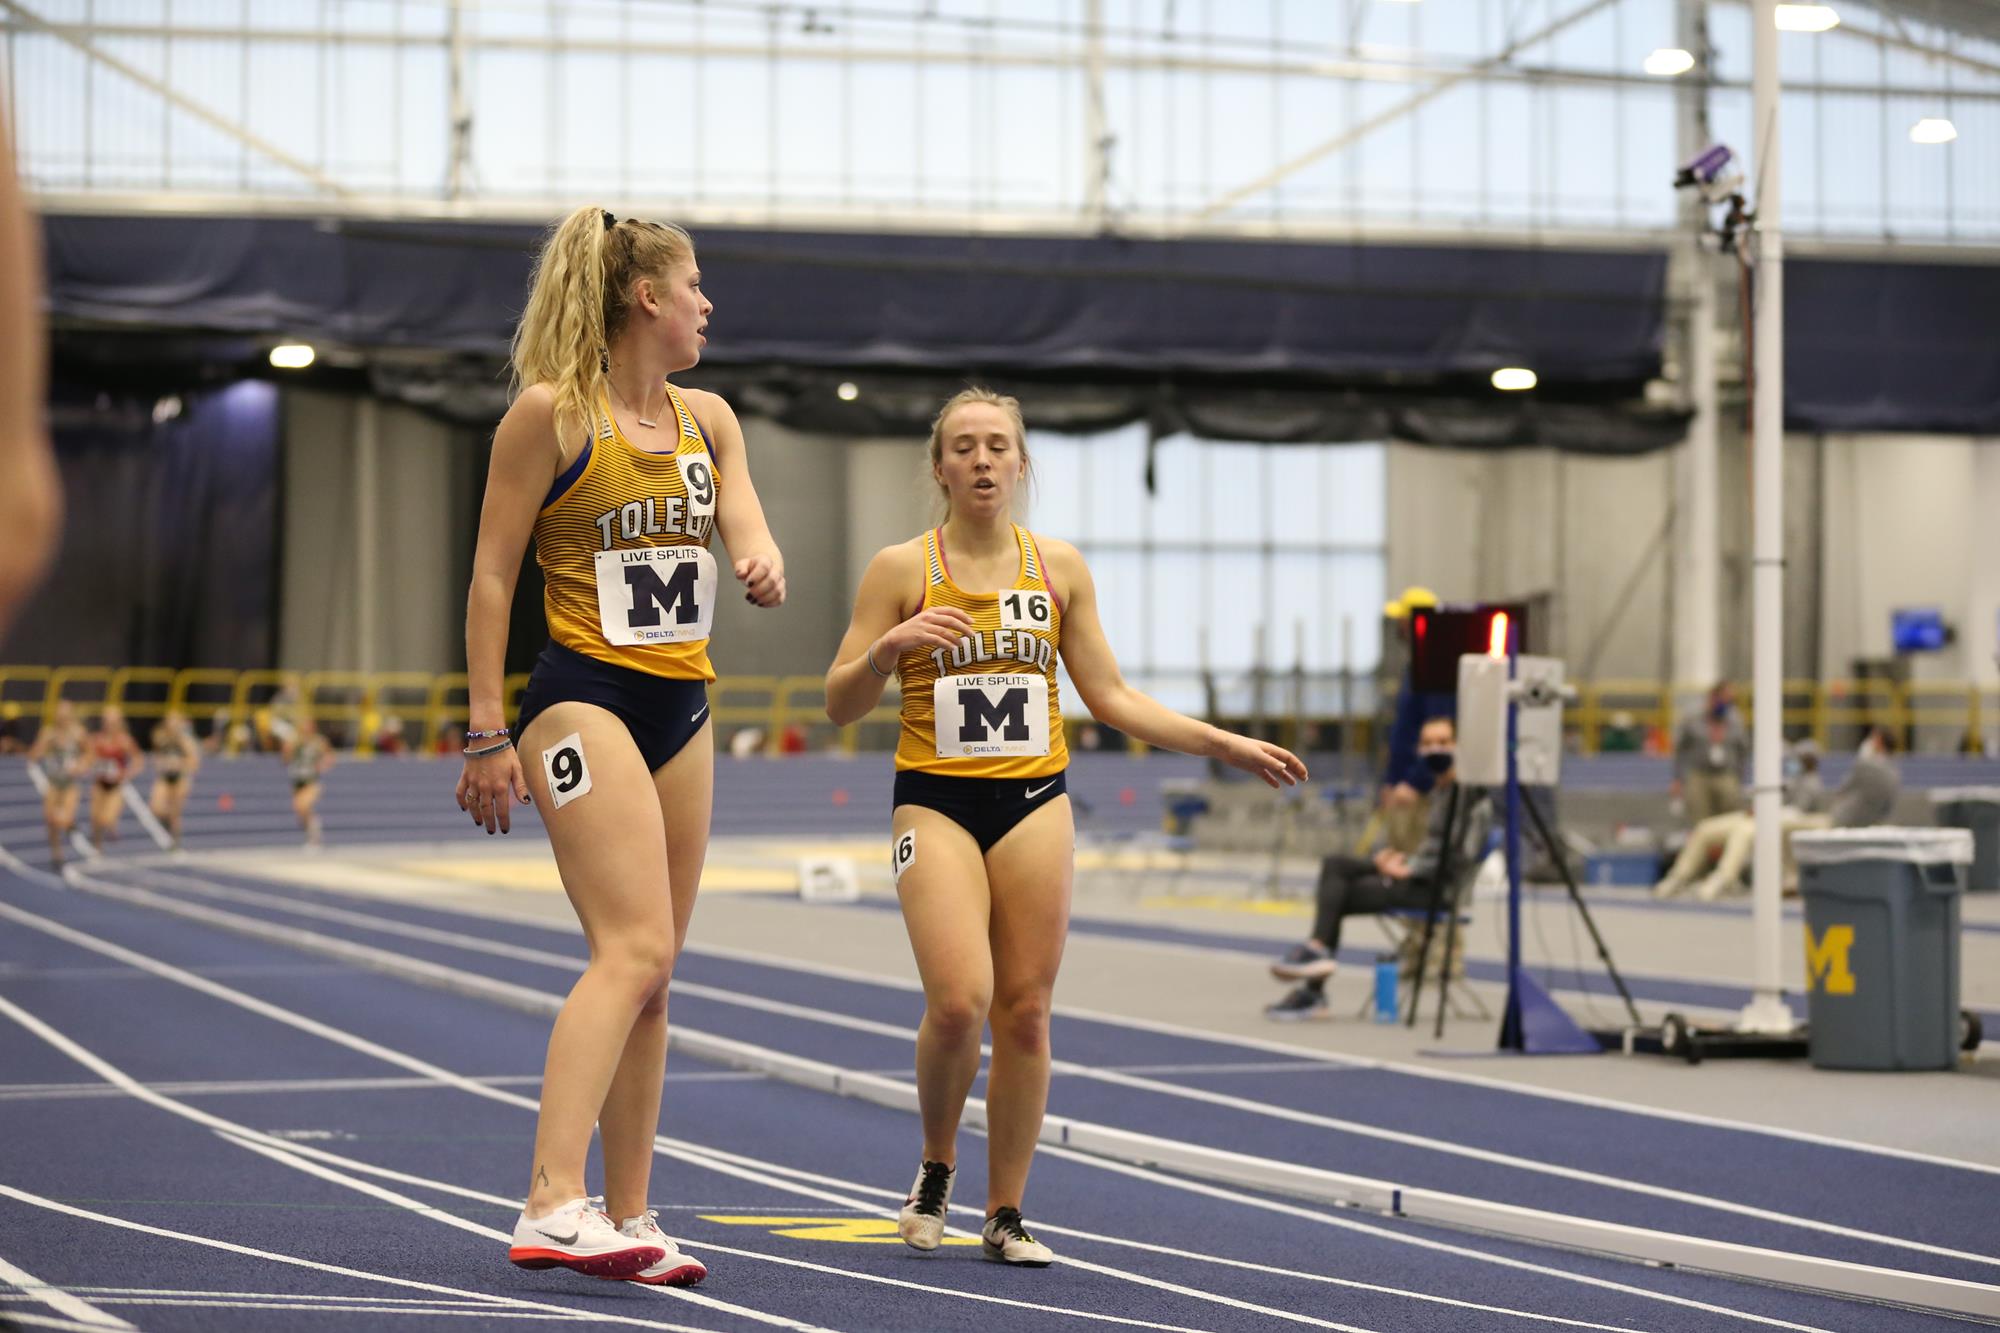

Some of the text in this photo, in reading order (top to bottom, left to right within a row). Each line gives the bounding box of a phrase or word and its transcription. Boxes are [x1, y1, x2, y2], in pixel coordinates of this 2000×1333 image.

[687, 462, 713, 505] 9
[621, 549, 698, 562] LIVE SPLITS
[624, 562, 699, 627] M
[1005, 594, 1048, 622] 16
[931, 629, 1052, 678] TOLEDO
[956, 676, 1030, 686] LIVE SPLITS
[958, 688, 1030, 742] M
[552, 747, 583, 793] 9
[1804, 922, 1855, 995] M
